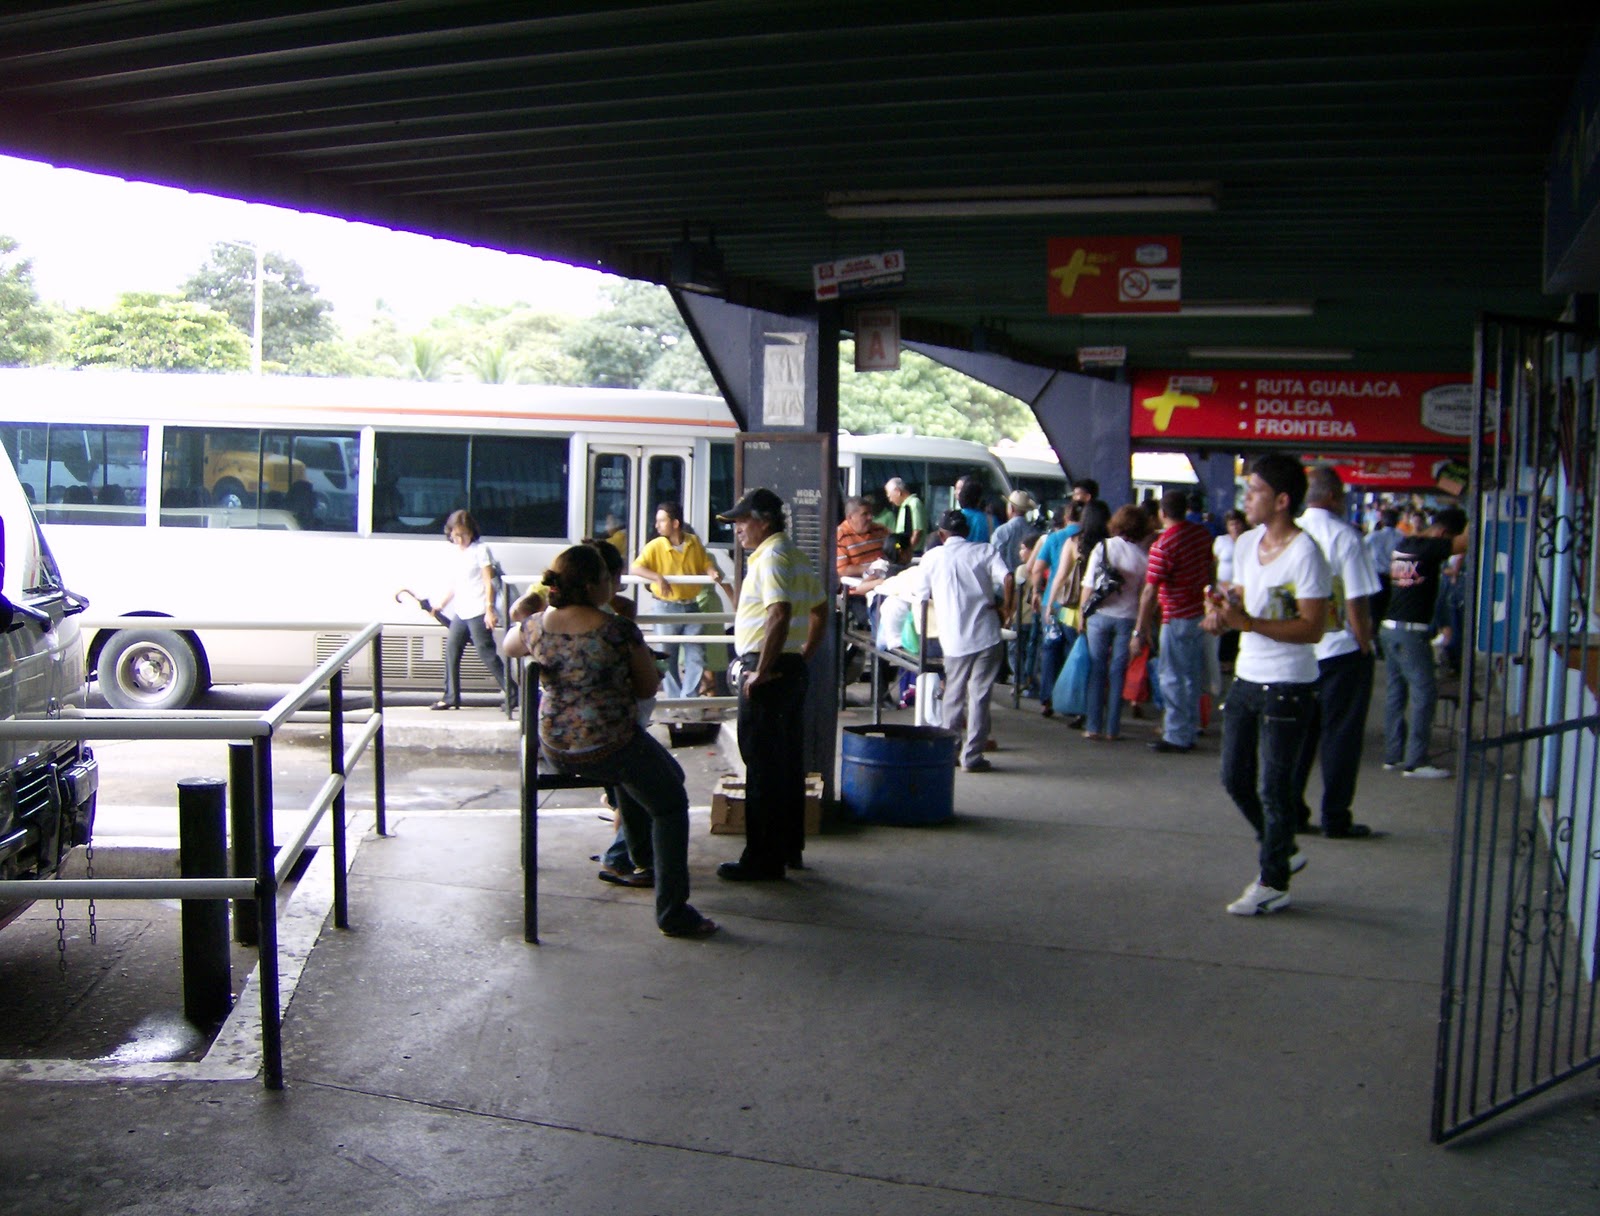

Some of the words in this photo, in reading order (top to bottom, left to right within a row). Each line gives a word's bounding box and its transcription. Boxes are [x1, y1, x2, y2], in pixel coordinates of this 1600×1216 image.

[867, 330, 886, 360] A
[1255, 379, 1305, 396] RUTA
[1309, 380, 1400, 397] GUALACA
[1255, 400, 1334, 417] DOLEGA
[1255, 419, 1356, 437] FRONTERA
[744, 442, 771, 450] NOTA
